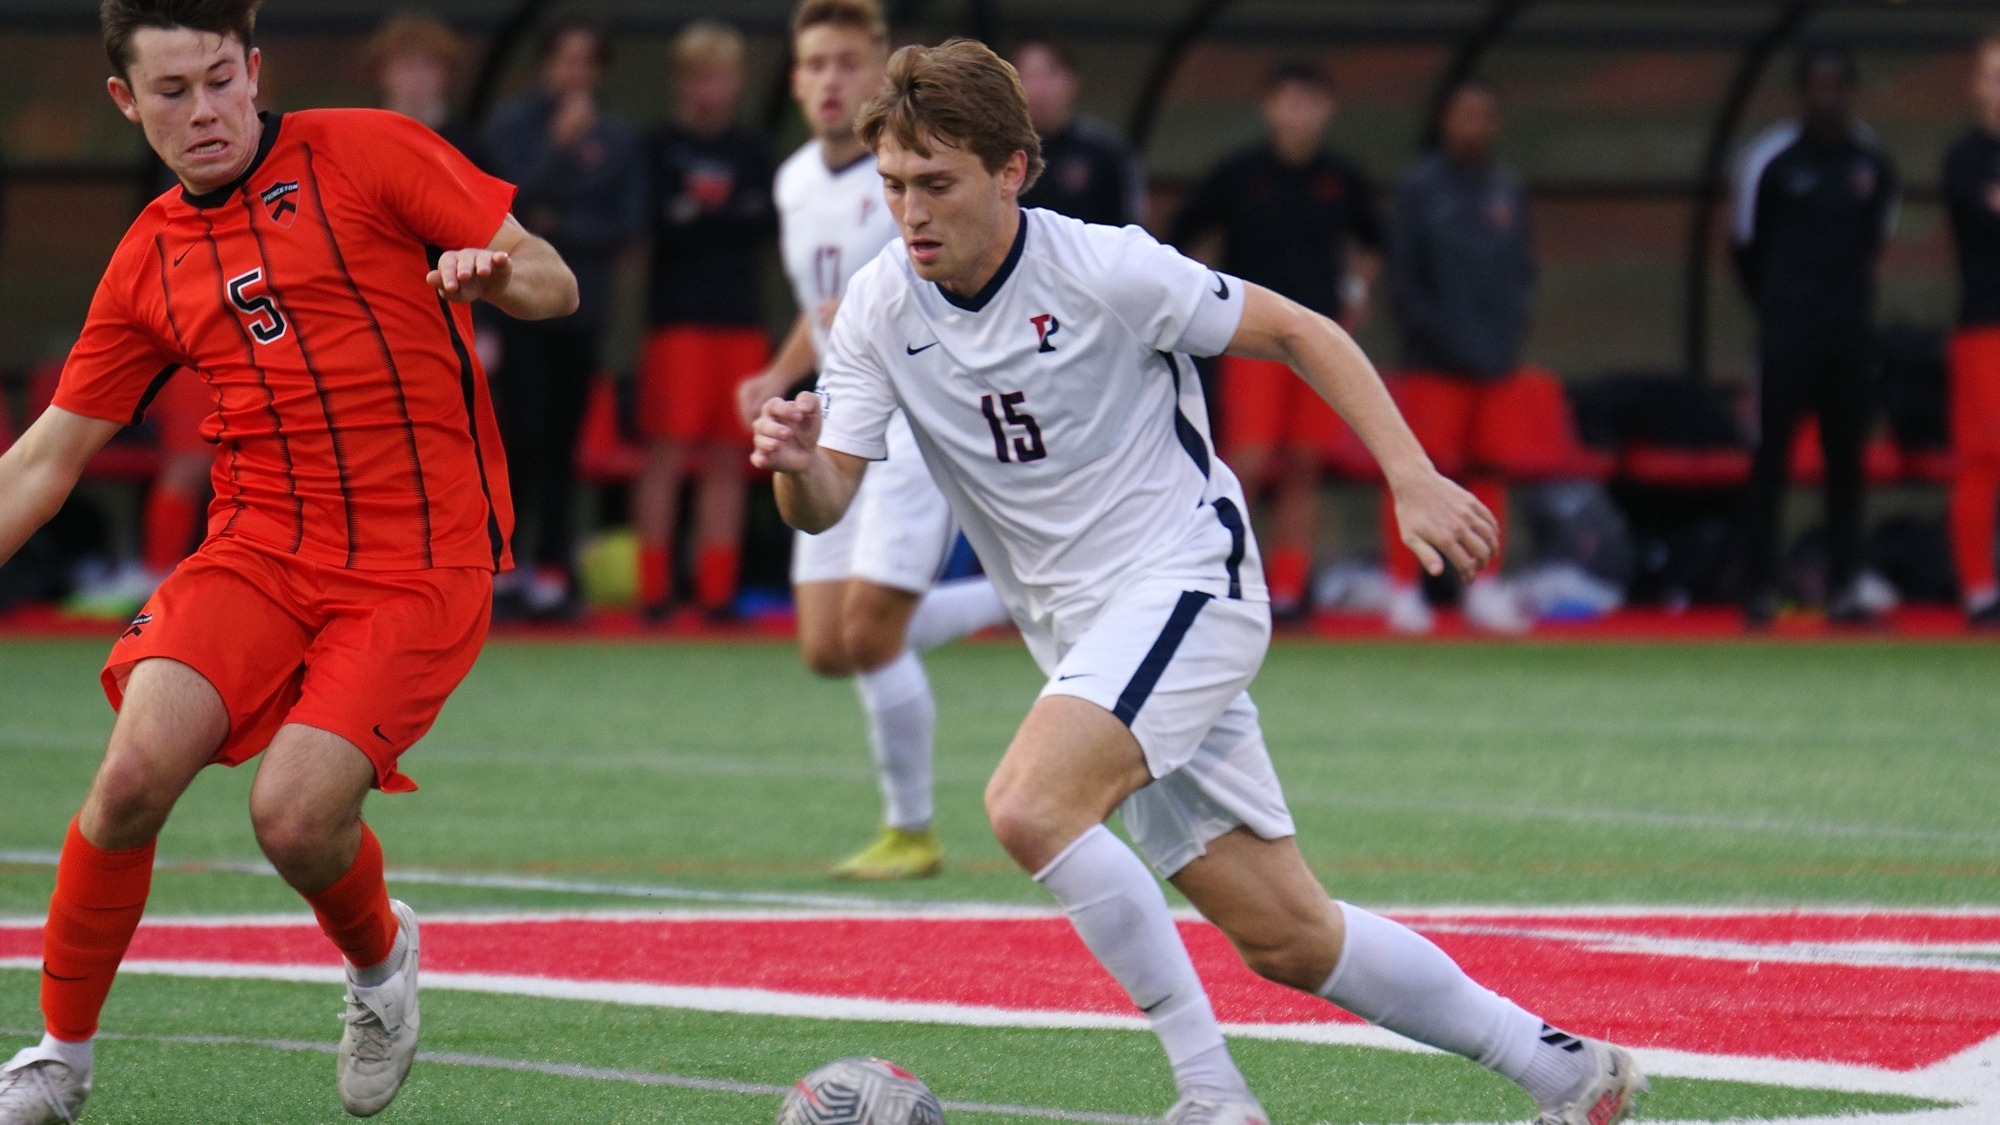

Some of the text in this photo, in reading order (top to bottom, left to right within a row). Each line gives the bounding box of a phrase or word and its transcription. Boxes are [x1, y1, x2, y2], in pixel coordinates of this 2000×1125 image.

[814, 246, 842, 299] 17
[227, 267, 287, 345] 5
[1030, 313, 1059, 353] P
[981, 391, 1046, 462] 15
